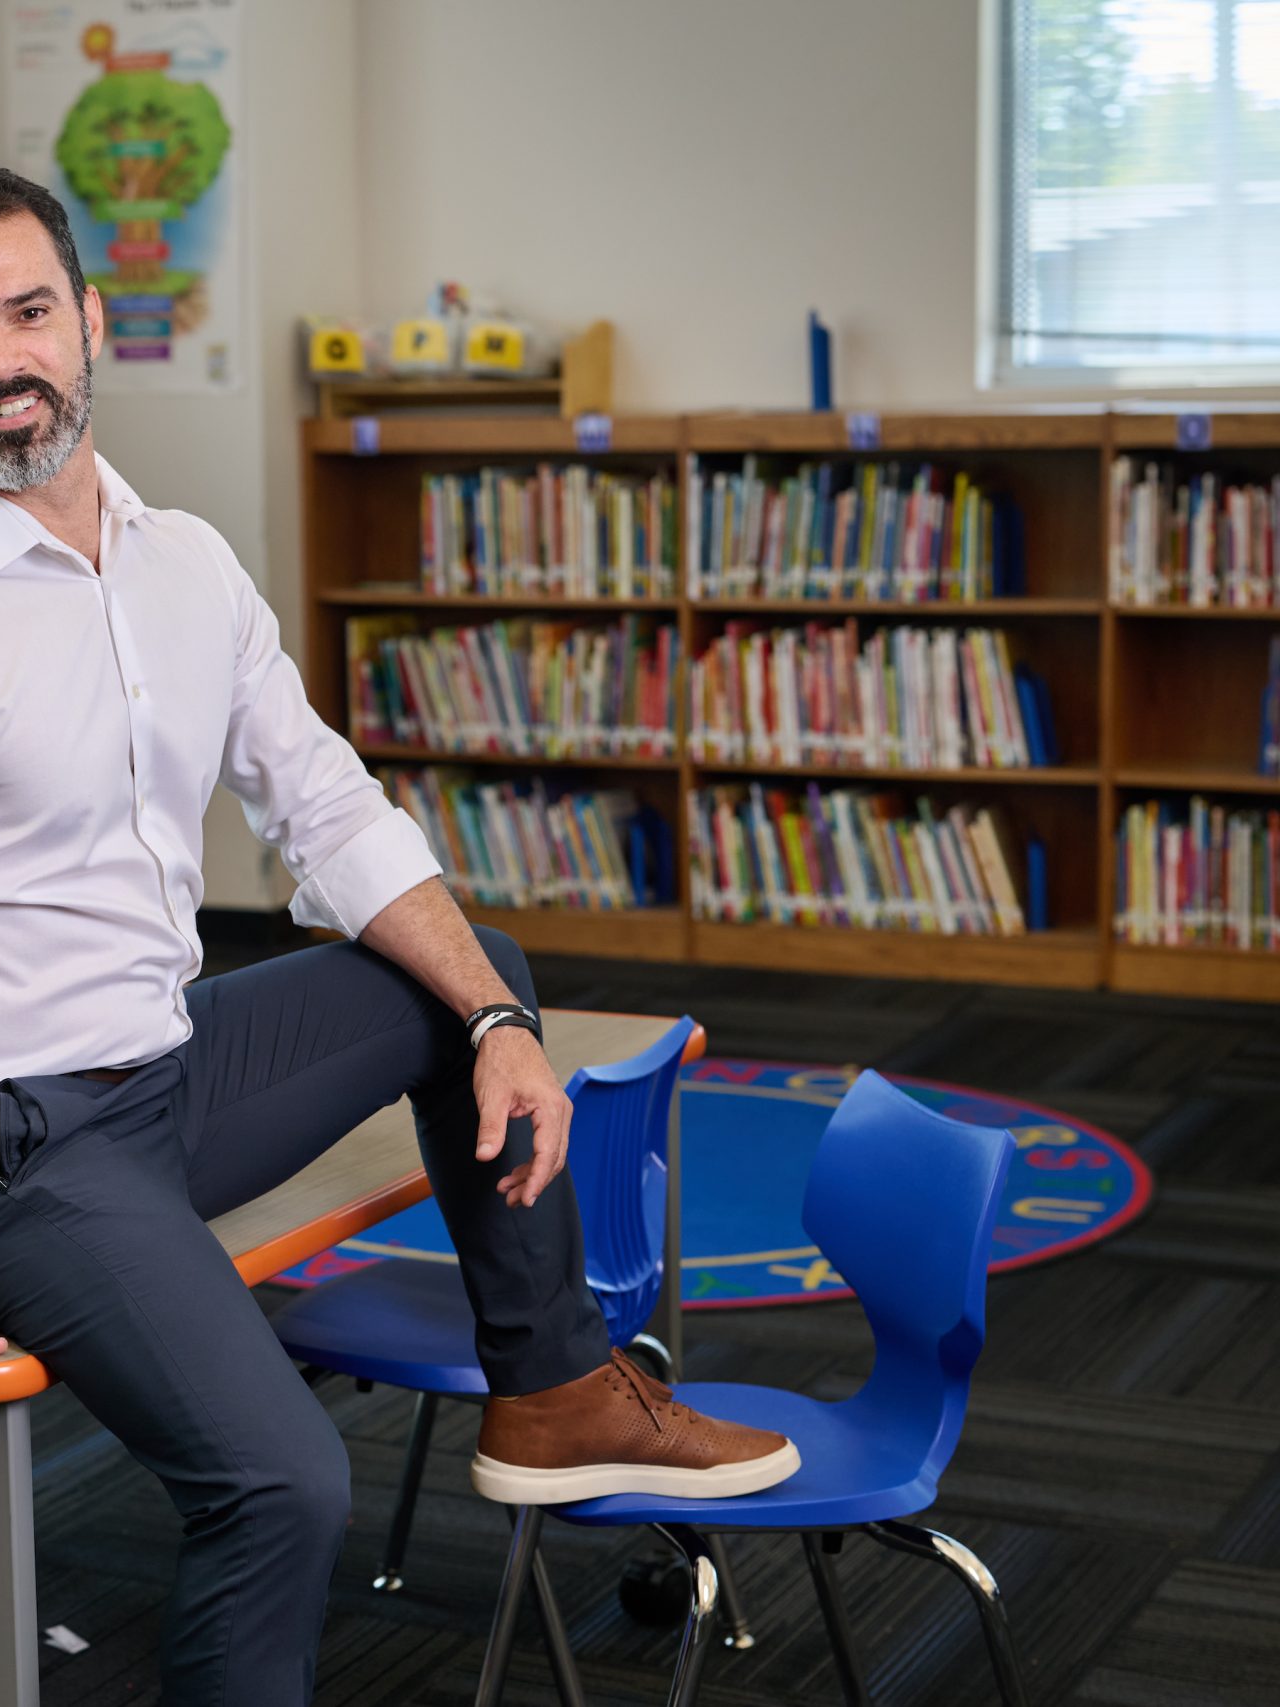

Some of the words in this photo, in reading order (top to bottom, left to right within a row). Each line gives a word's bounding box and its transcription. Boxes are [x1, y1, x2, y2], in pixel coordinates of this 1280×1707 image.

[1026, 1149, 1111, 1171] S
[1011, 1197, 1106, 1224] U
[769, 1259, 847, 1292] X
